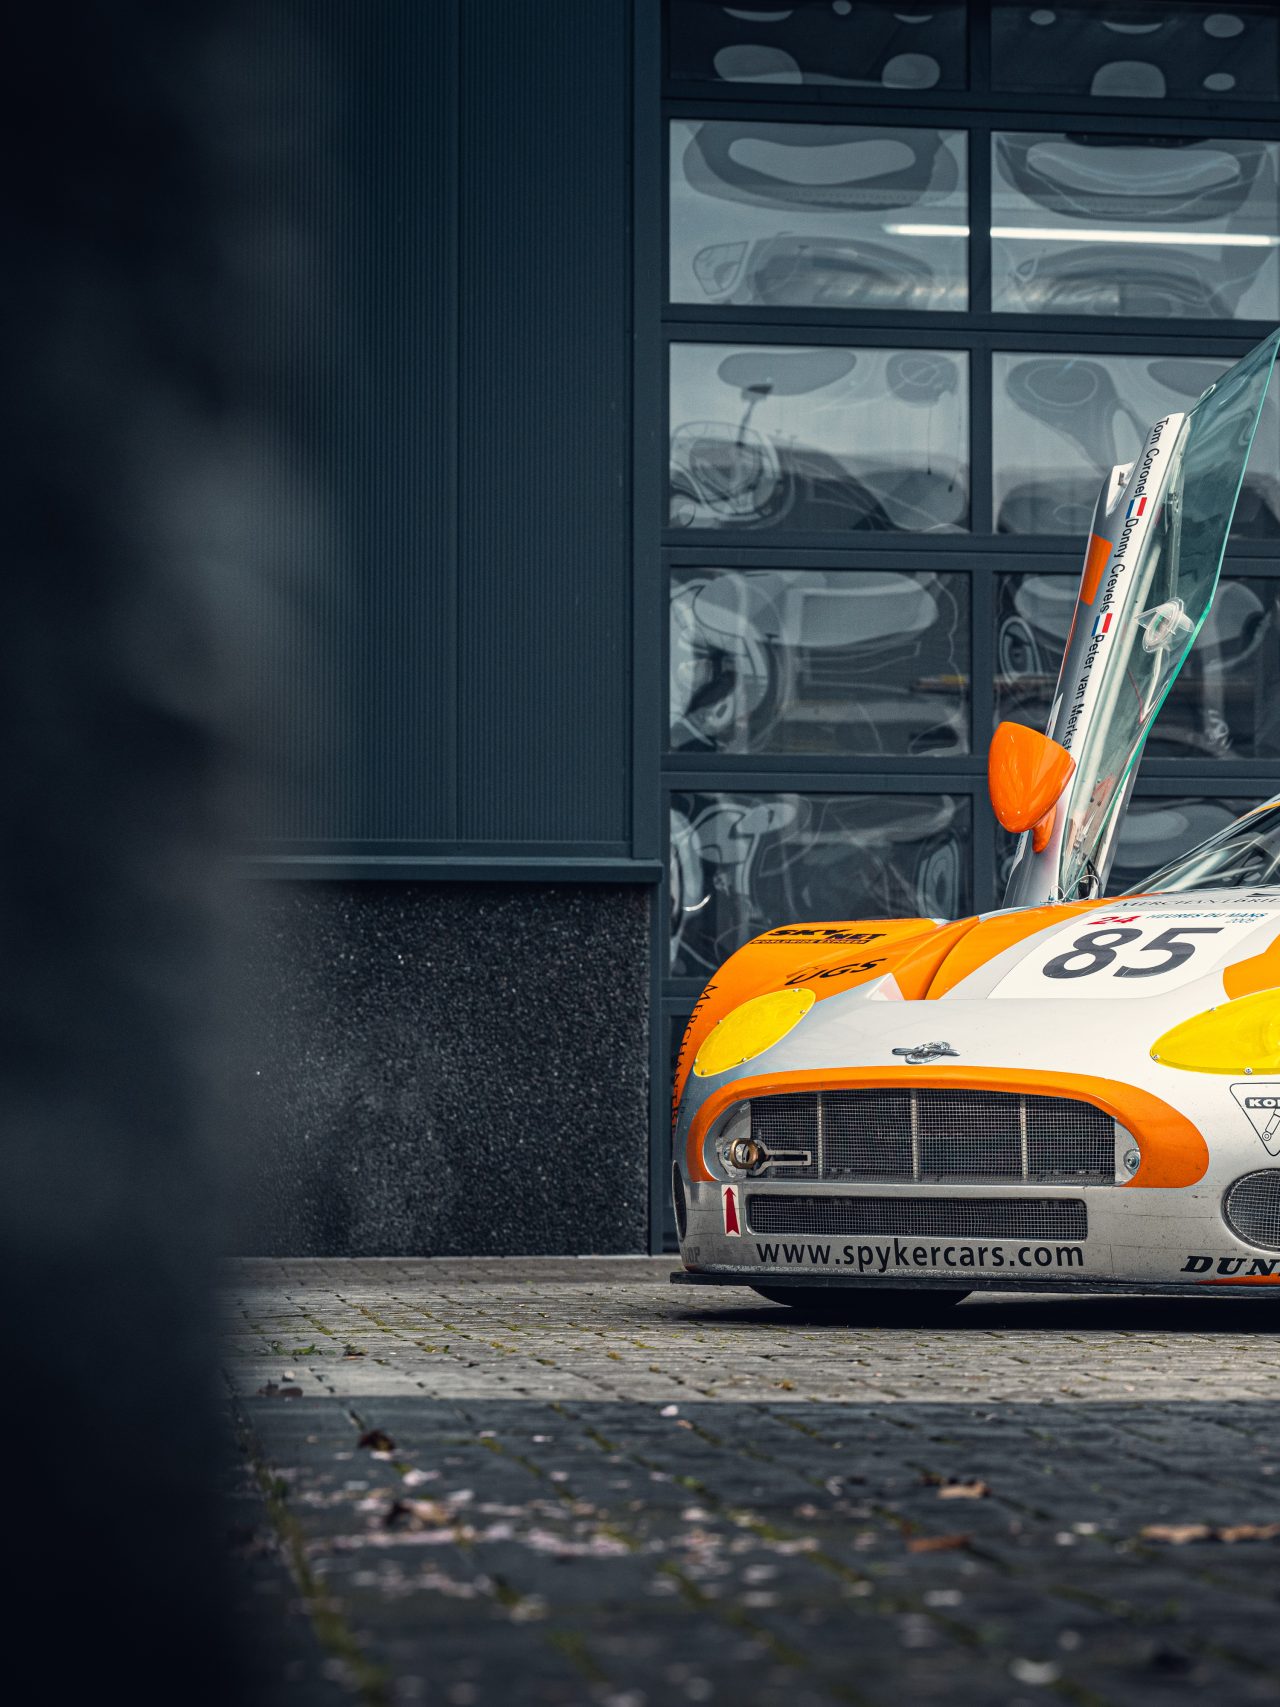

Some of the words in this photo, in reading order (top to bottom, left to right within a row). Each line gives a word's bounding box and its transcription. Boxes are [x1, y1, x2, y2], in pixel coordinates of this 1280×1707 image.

[1150, 417, 1170, 445] Tom
[1134, 448, 1160, 498] Coronel
[1113, 518, 1139, 561] Donny
[1100, 563, 1126, 613] Crevels
[1084, 634, 1105, 669] Peter
[1075, 675, 1090, 700] van
[1085, 915, 1141, 925] 24
[1042, 927, 1225, 979] 85
[785, 958, 888, 986] UGS
[756, 1239, 1084, 1272] www.spykercars.com
